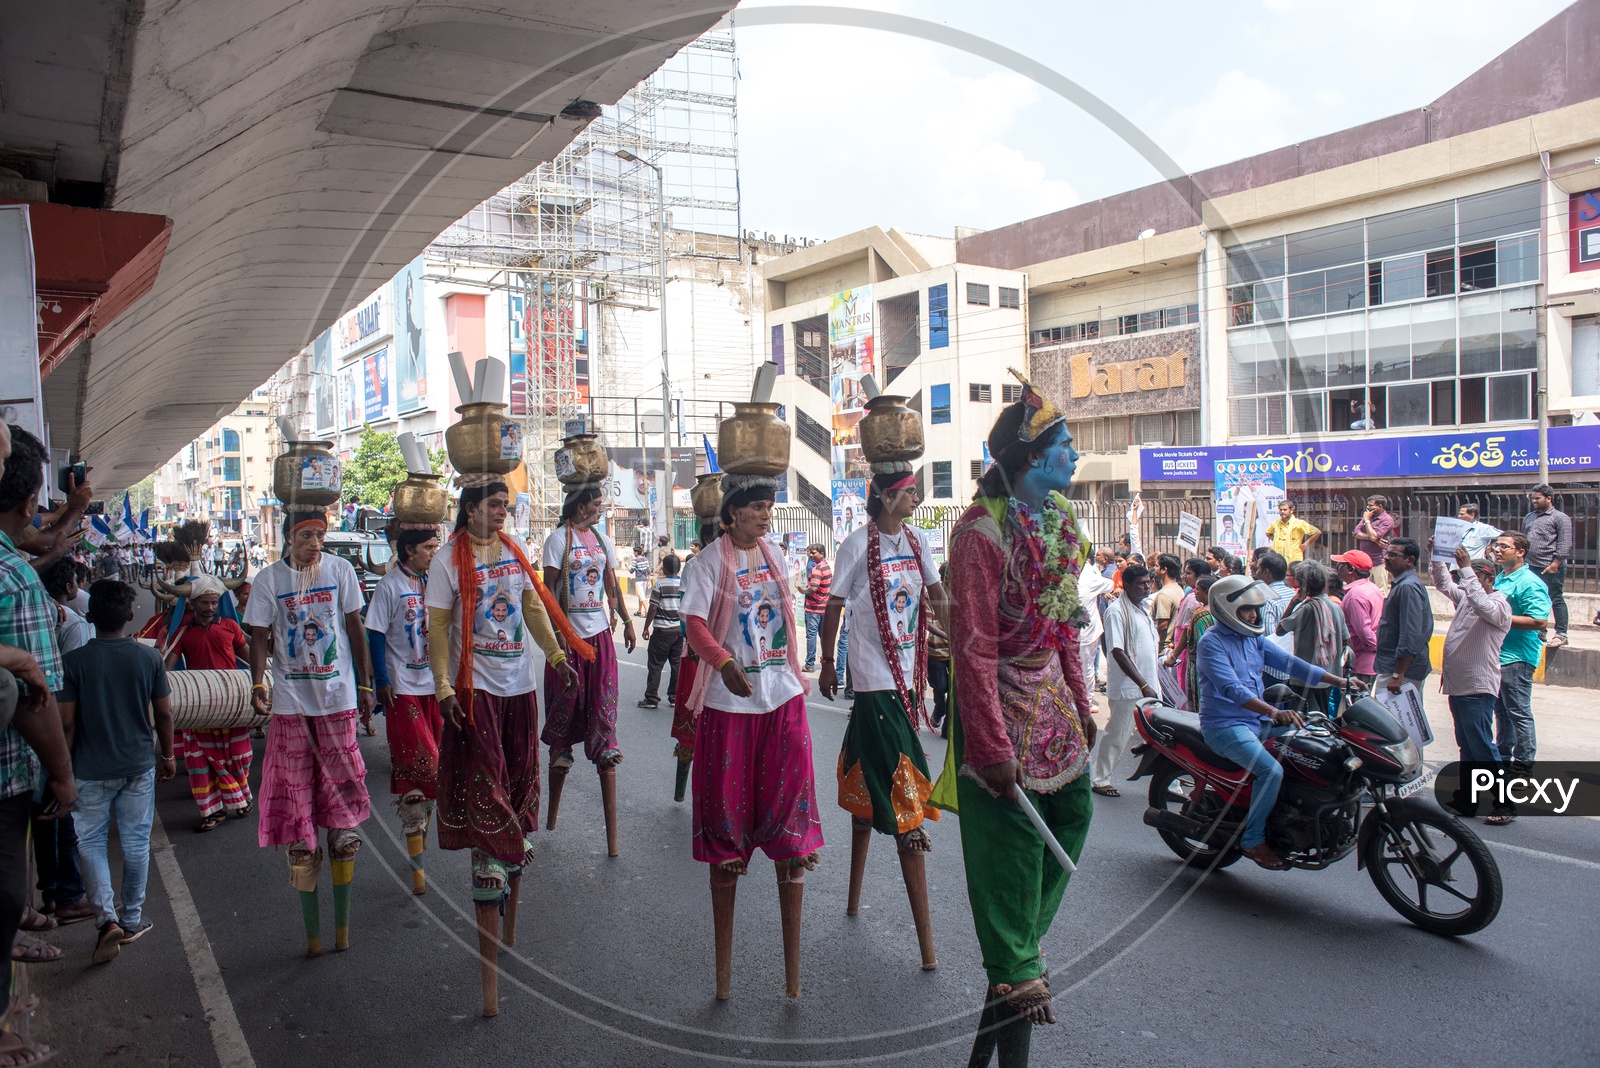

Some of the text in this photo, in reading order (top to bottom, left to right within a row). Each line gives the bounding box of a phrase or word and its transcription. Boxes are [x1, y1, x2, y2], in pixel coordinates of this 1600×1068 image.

[831, 312, 871, 330] MANTRIS
[1431, 436, 1506, 469] శరత్
[1511, 459, 1540, 467] DOLBY
[1351, 464, 1361, 472] 4K
[486, 641, 499, 650] KK
